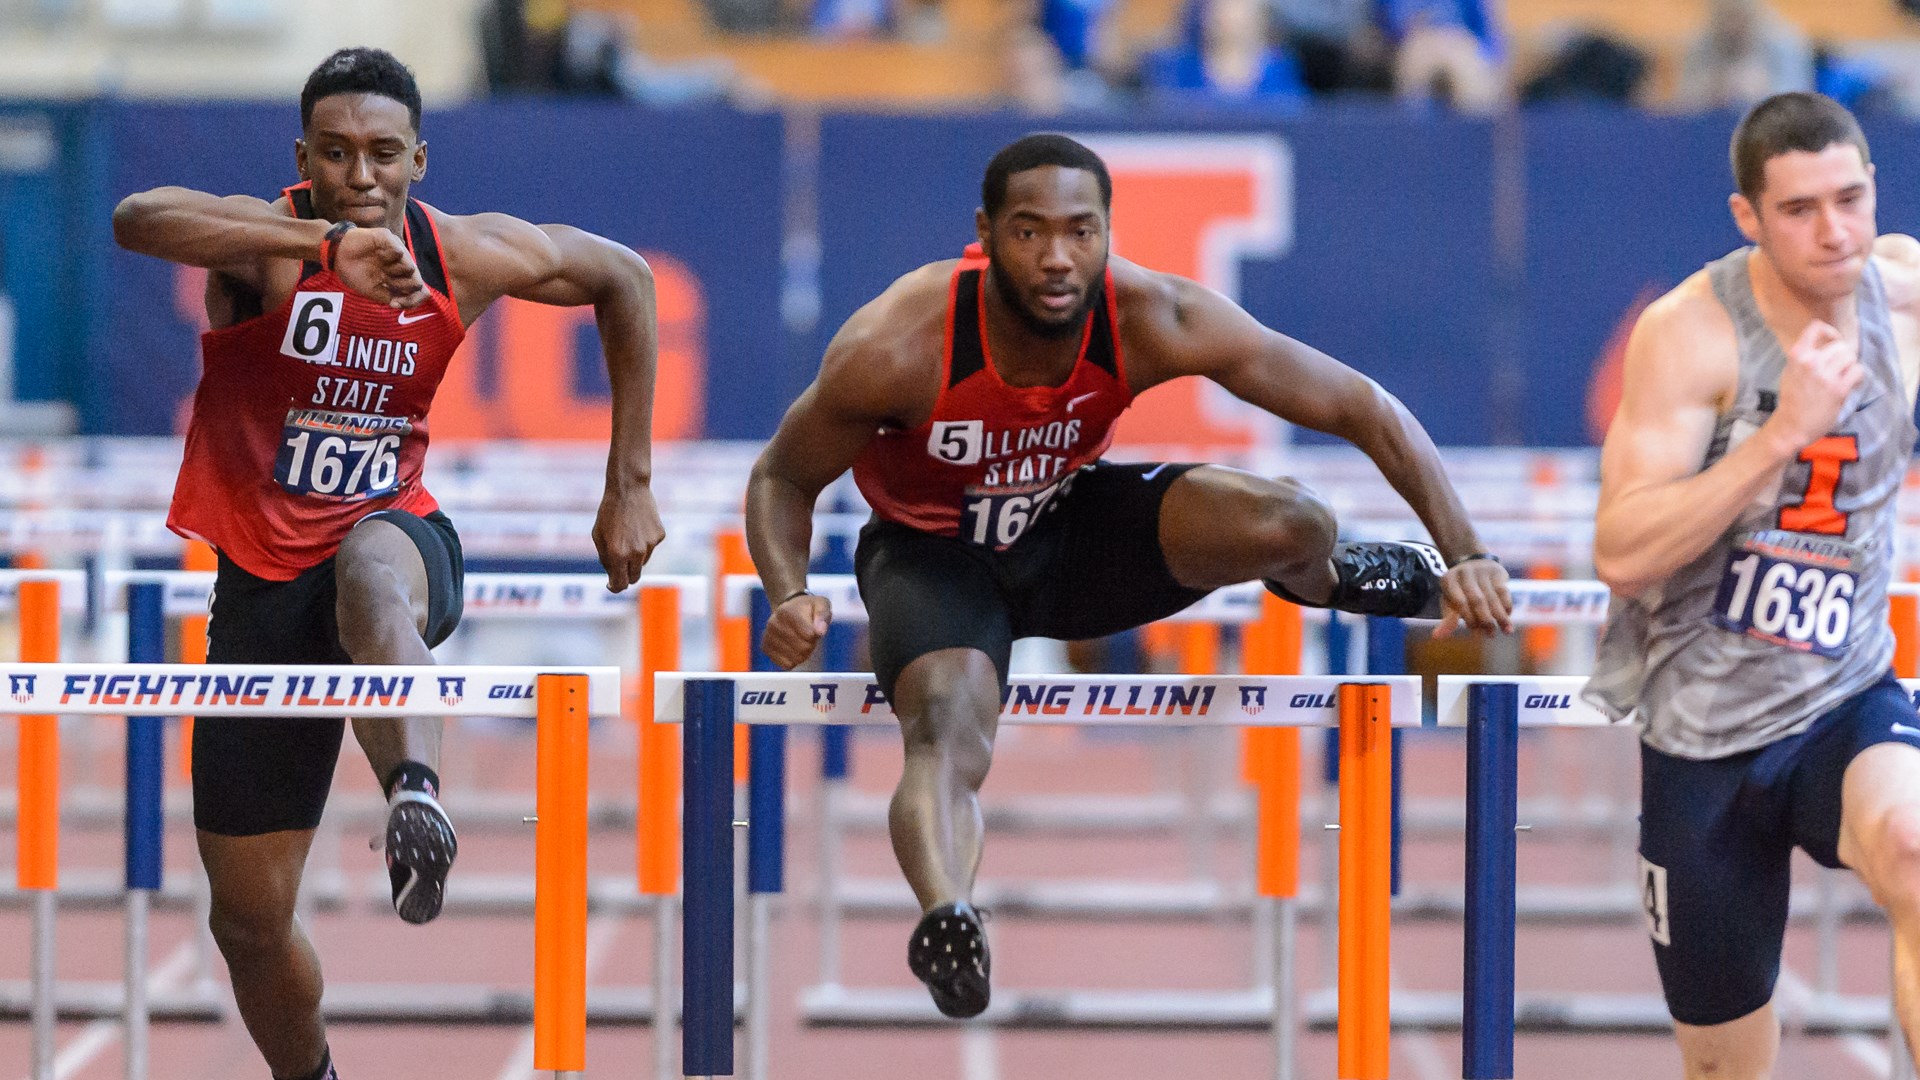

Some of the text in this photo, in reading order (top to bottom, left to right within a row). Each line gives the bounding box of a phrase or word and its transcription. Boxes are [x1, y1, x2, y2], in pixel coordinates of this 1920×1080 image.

[292, 297, 334, 356] 6
[305, 332, 418, 377] LINOIS
[311, 375, 393, 414] STATE
[296, 410, 406, 437] ILLINOIS
[984, 419, 1082, 459] LLINOIS
[938, 424, 969, 461] 5
[286, 433, 401, 495] 1676
[984, 453, 1068, 486] STATE
[1777, 432, 1859, 536] I
[967, 474, 1075, 545] 167
[1726, 554, 1855, 649] 1636
[59, 674, 415, 707] FIGHTING ILLINI
[488, 684, 535, 699] GILL
[740, 691, 788, 706] GILL
[860, 683, 1216, 716] FING ILLINI
[1289, 693, 1336, 708] GILL
[1524, 693, 1572, 709] GILL
